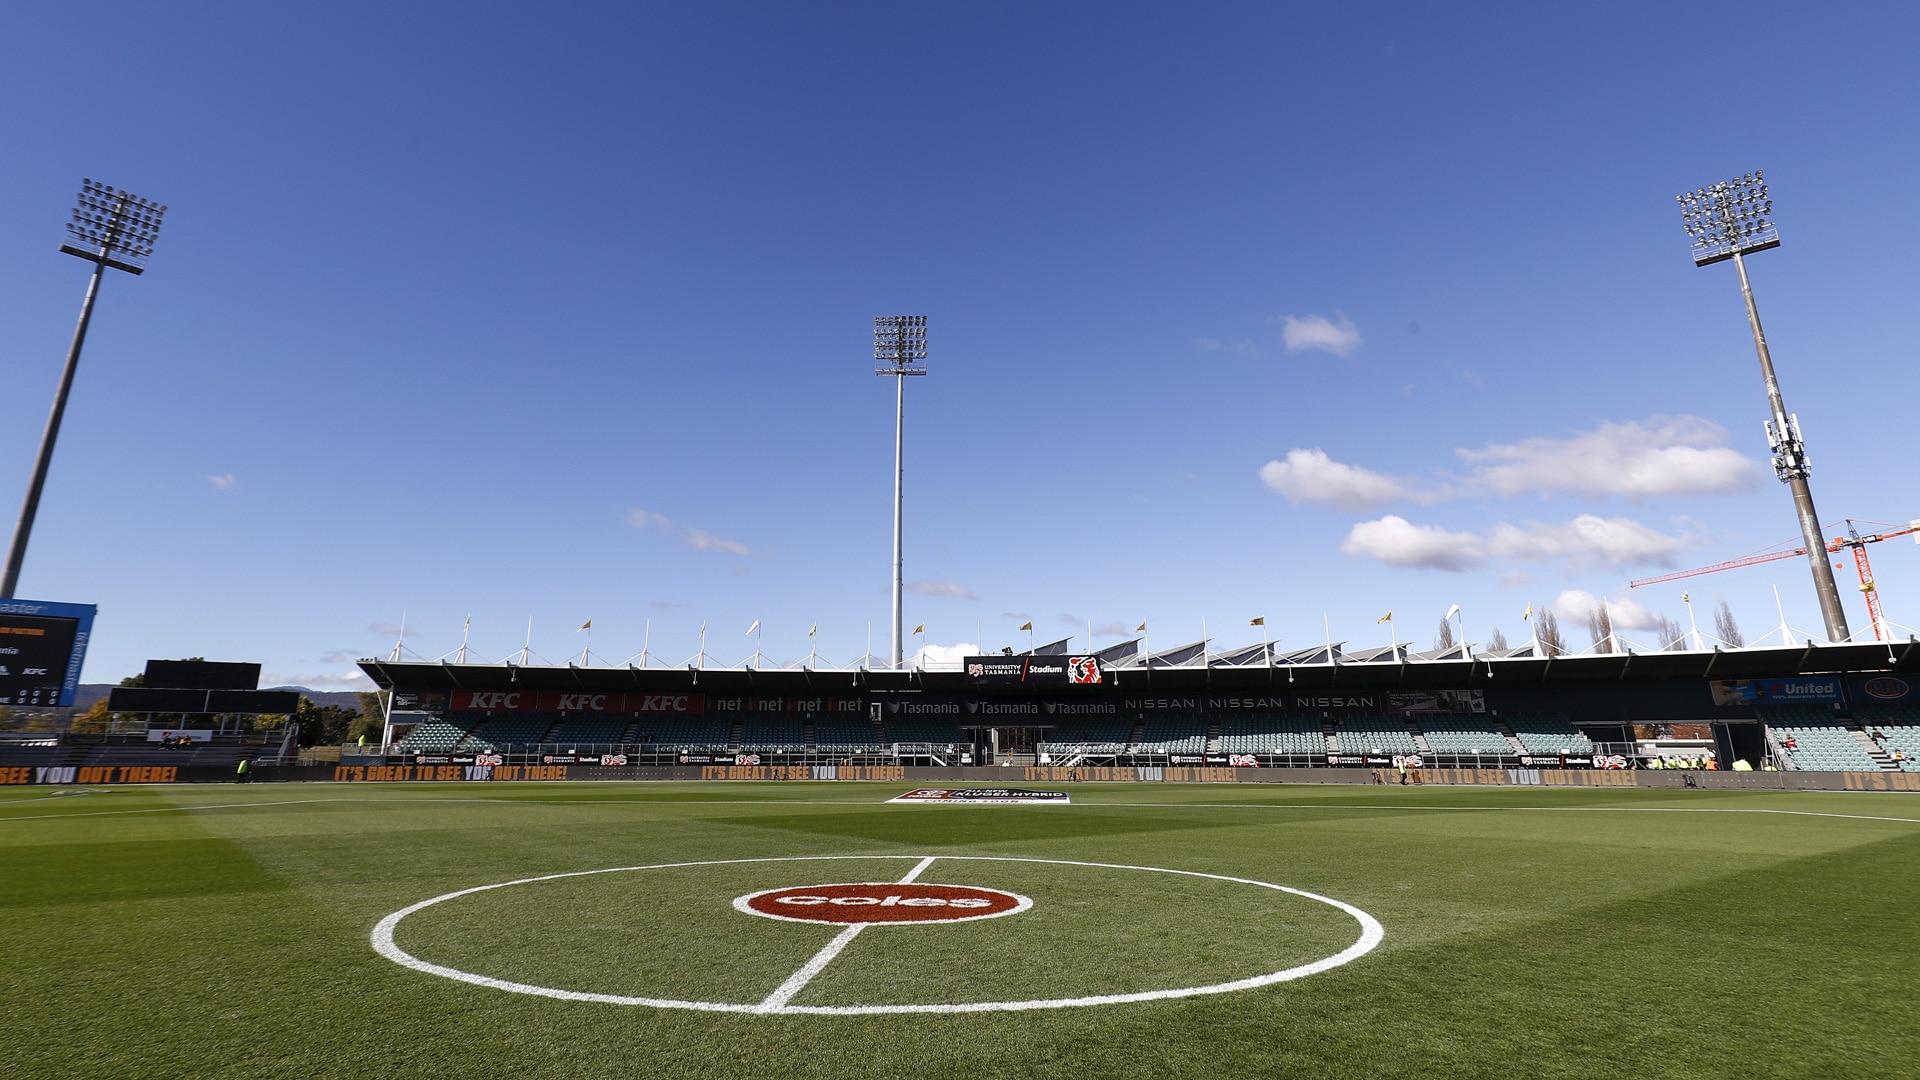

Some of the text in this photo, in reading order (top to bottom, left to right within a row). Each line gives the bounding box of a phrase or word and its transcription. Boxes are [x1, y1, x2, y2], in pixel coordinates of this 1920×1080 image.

[64, 631, 88, 690] ticketmaster
[1029, 665, 1062, 673] Stadium
[1786, 682, 1834, 694] United
[468, 692, 520, 709] KFC
[557, 694, 607, 710] KFC
[641, 696, 688, 711] KFC
[902, 701, 960, 714] Tasmania
[1126, 699, 1194, 708] NISSAN
[1210, 698, 1282, 708] NISSAN
[1297, 698, 1374, 707] NISSAN
[980, 702, 1038, 714] Tasmania
[1057, 702, 1116, 714] Tasmania
[0, 766, 178, 784] SEE YOU OUT THERE!
[334, 766, 364, 780] IT'S
[367, 766, 412, 780] GREAT
[416, 766, 434, 780] TO
[437, 766, 462, 780] SEE
[494, 766, 520, 780] OUT
[524, 766, 568, 780] THERE!
[702, 766, 904, 780] IT'S GREAT TO SEE YOU OUT THERE!
[1024, 766, 1048, 780] IT'S
[1094, 766, 1110, 780] TO
[1112, 766, 1134, 780] SEE
[1137, 767, 1162, 780] YOU
[1165, 767, 1190, 780] OUT
[1194, 767, 1237, 781] THERE!
[1406, 768, 1450, 783] GEAT
[1454, 769, 1474, 784] TO
[1478, 769, 1505, 784] SEE
[1508, 769, 1541, 784] YOU
[1544, 770, 1575, 784] OUT
[1579, 770, 1638, 786] THERE!
[1842, 772, 1887, 789] IT'S
[775, 896, 992, 908] coles
